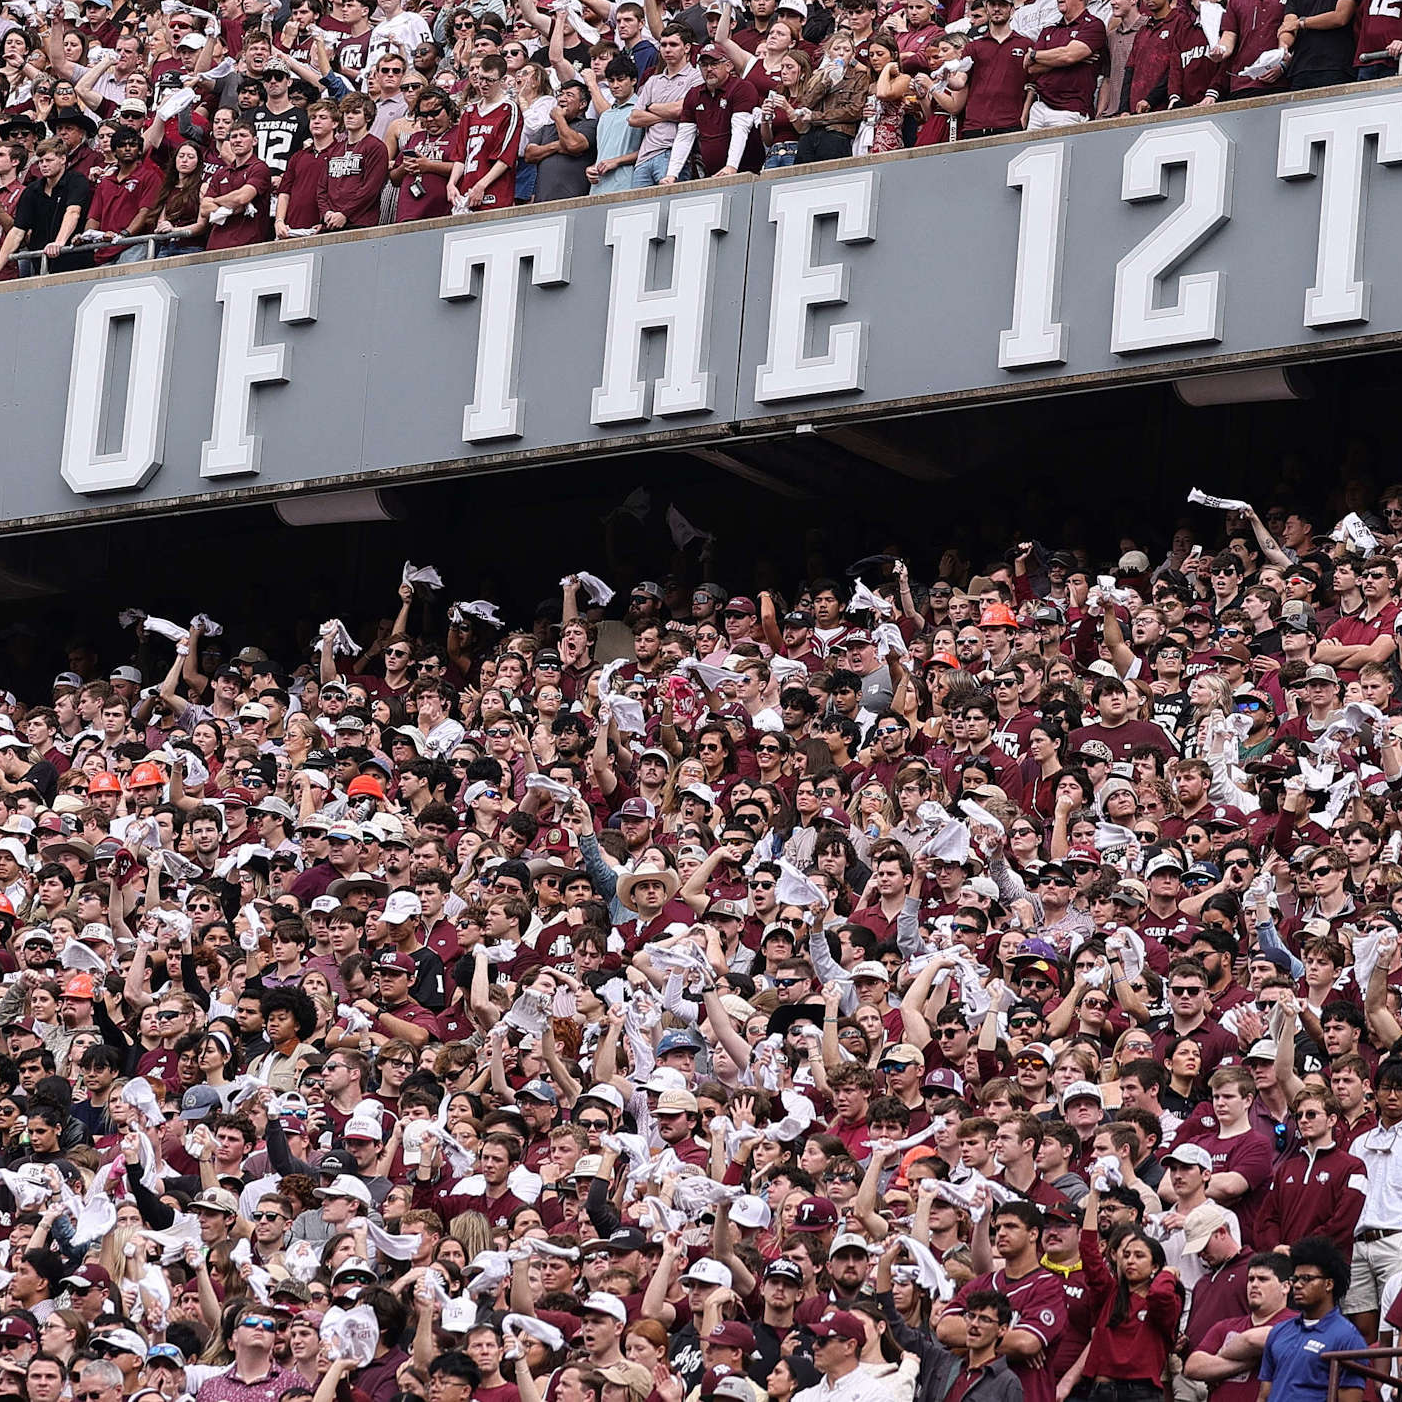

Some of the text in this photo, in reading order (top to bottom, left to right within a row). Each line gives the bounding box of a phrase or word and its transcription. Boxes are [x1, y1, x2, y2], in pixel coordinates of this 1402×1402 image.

[420, 32, 433, 42] 12
[1180, 45, 1204, 68] TEXAS
[254, 121, 298, 132] TEXAS A&M
[256, 130, 289, 164] 12
[60, 252, 320, 494] OF
[439, 170, 878, 442] THE
[801, 1204, 814, 1221] T
[0, 1319, 12, 1332] T
